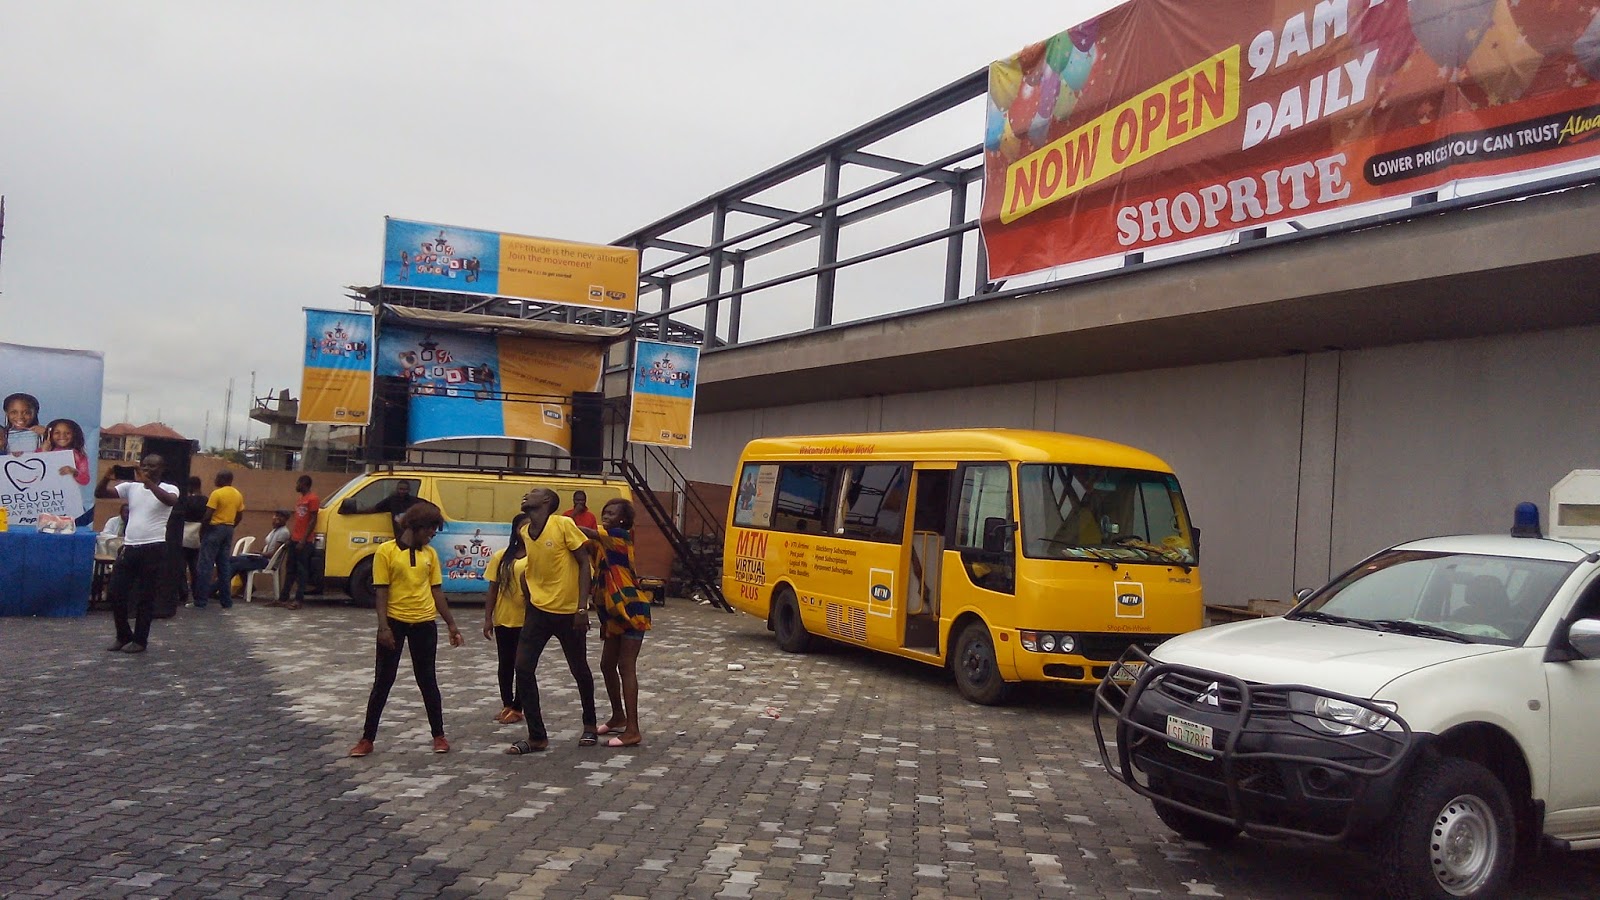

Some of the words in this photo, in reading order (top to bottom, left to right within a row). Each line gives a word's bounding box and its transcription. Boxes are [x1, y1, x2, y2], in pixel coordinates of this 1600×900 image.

[1247, 0, 1349, 82] 9AM
[1241, 48, 1380, 151] DAILY
[1008, 129, 1101, 215] NOW
[1111, 60, 1227, 165] OPEN
[1372, 155, 1413, 178] LOWER
[1447, 139, 1478, 158] YOU
[1482, 132, 1514, 153] CAN
[1516, 122, 1560, 147] TRUST
[1116, 154, 1352, 246] SHOPRITE
[508, 251, 527, 261] Join
[527, 253, 543, 263] the
[544, 256, 592, 269] movement!
[561, 248, 575, 258] the
[577, 251, 595, 260] new
[597, 253, 630, 265] attitude
[799, 445, 824, 455] Welcome
[824, 446, 831, 454] to
[830, 445, 841, 454] the
[840, 445, 855, 454] New
[855, 443, 876, 454] World
[1, 490, 64, 505] BRUSH
[36, 506, 65, 514] NIGHT
[736, 531, 769, 559] MTN
[735, 558, 766, 576] VIRTUAL
[740, 584, 759, 601] PLUS
[873, 588, 888, 600] MTN
[1121, 595, 1139, 604] MTN
[1106, 624, 1152, 633] Shop-On-Wheels
